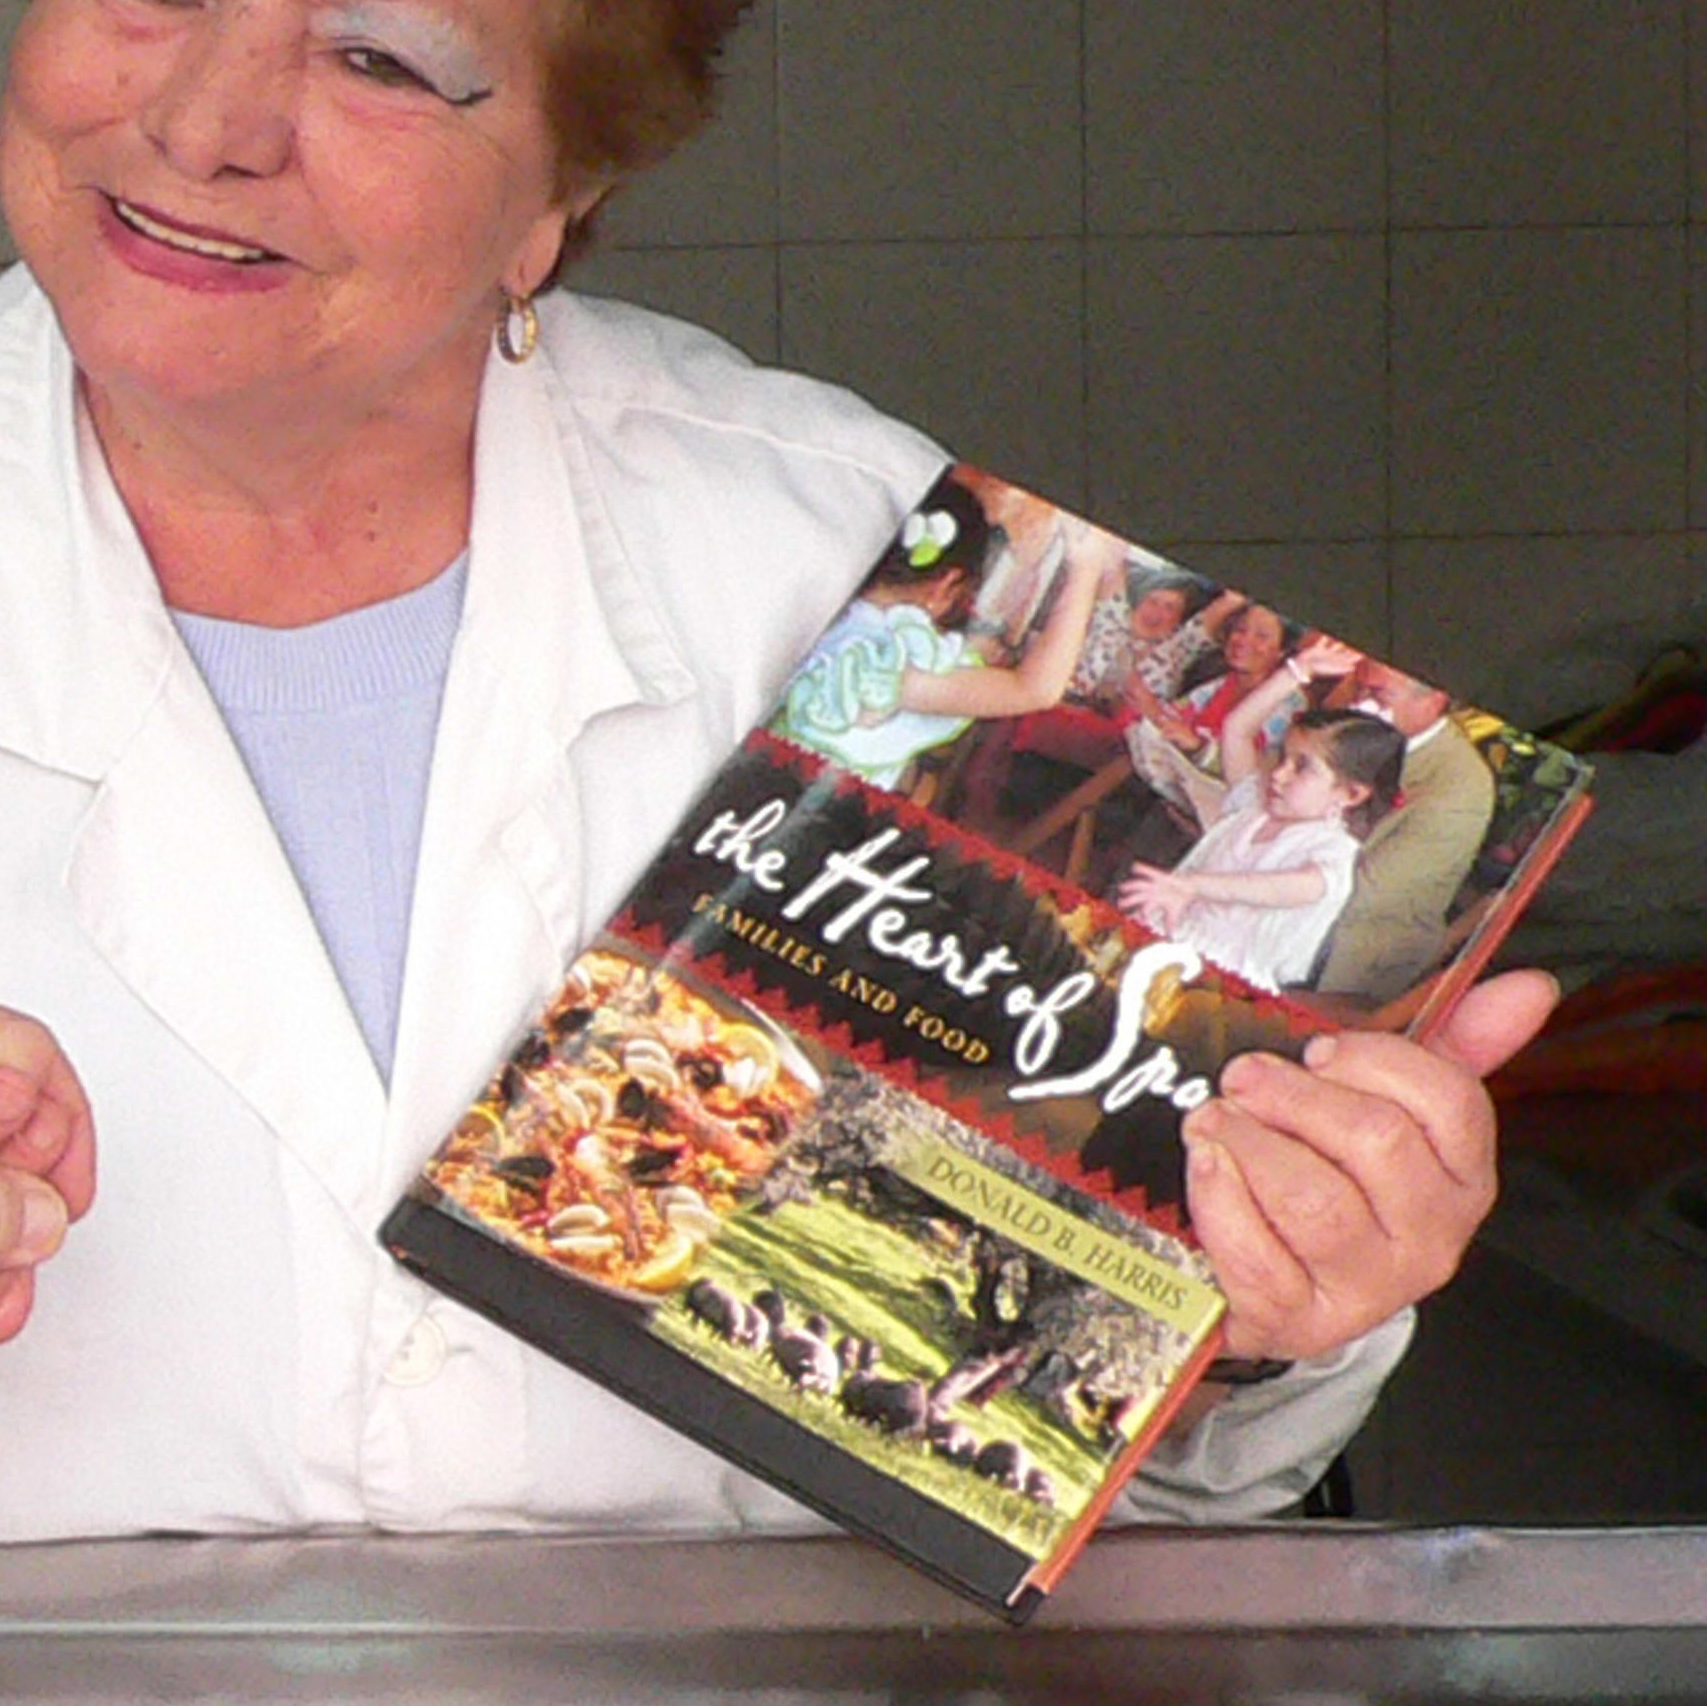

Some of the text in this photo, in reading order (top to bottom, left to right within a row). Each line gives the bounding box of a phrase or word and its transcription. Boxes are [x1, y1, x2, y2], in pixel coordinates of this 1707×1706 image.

[691, 892, 990, 1065] FAMILIES AND FOOD
[693, 797, 787, 891] the
[780, 826, 1020, 996] Heart
[1004, 971, 1097, 1074] of
[927, 1155, 1187, 1311] DONALD B. HARRIS
